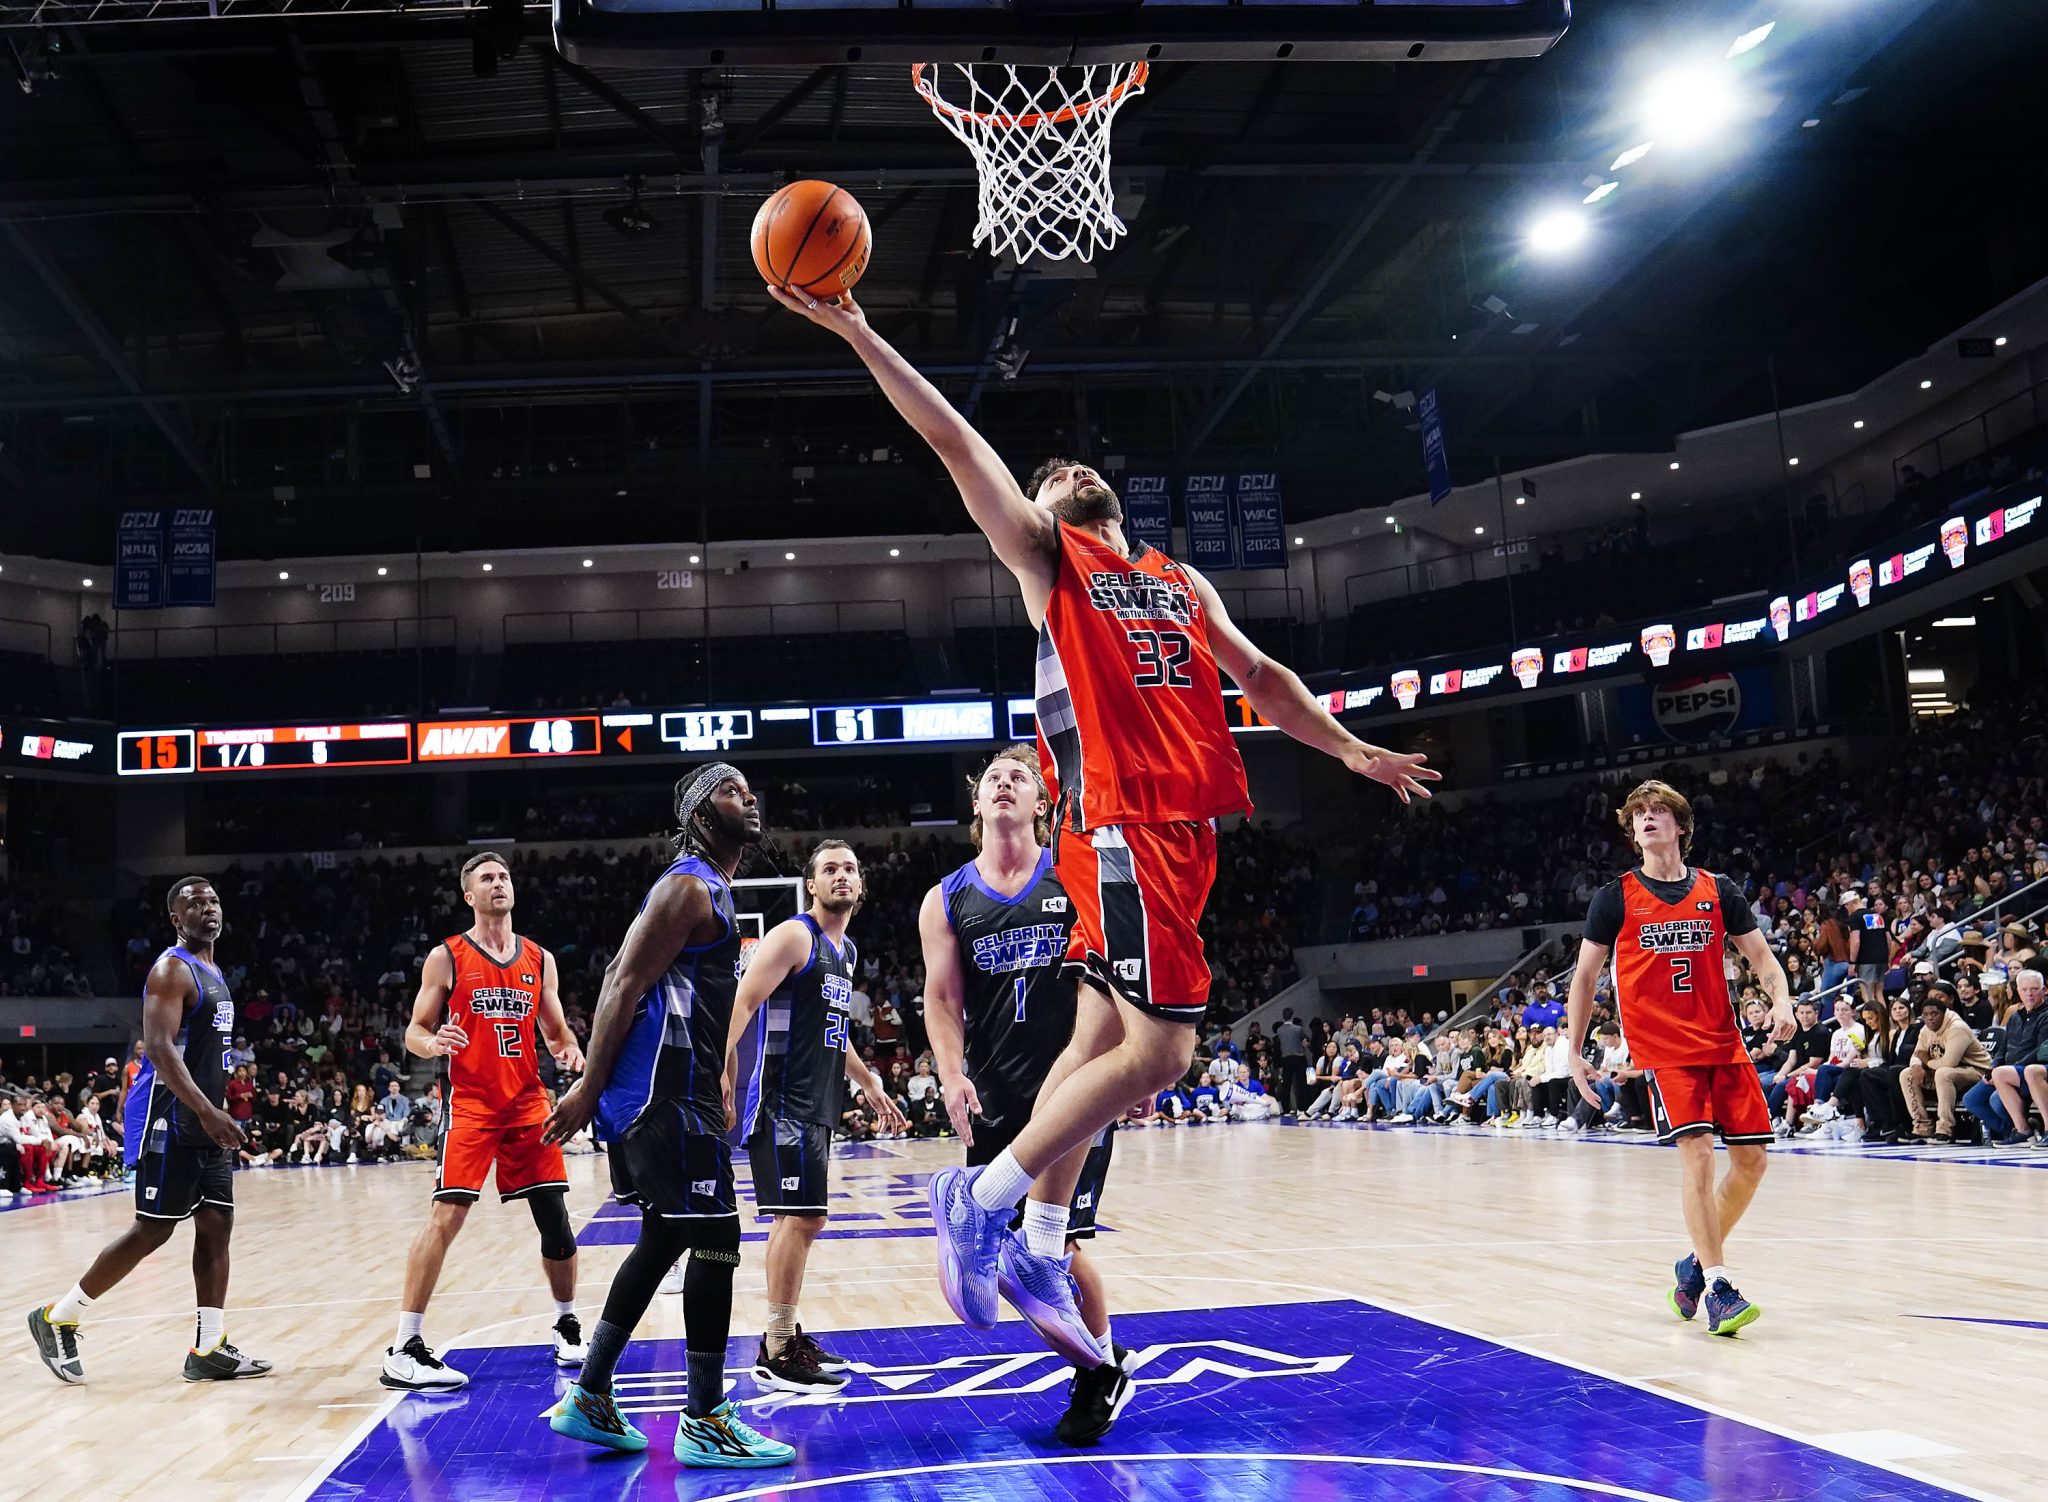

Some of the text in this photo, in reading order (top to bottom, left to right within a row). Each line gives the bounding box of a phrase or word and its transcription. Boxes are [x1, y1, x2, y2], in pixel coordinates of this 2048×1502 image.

[1128, 477, 1165, 493] GCU
[1187, 475, 1225, 491] GCU
[1239, 474, 1275, 490] GCU
[120, 512, 160, 528] GCU
[173, 509, 213, 525] GCU
[1132, 517, 1166, 529] WAC
[1191, 511, 1225, 522] WAC
[1243, 509, 1277, 520] WAC
[174, 543, 210, 554] NCAA
[1195, 540, 1226, 552] 2021
[1246, 538, 1280, 551] 2023
[657, 571, 692, 589] 208
[1090, 571, 1190, 593] CELEBRT
[321, 584, 355, 602] 209
[1116, 609, 1156, 620] MOTIVATE
[1165, 610, 1190, 627] IPIRE
[1128, 630, 1192, 688] 32
[1657, 687, 1736, 716] PEPSI
[835, 708, 875, 742] 51
[903, 706, 992, 738] HOME
[420, 726, 508, 756] AWAY
[529, 719, 574, 753] 46
[136, 735, 178, 770] 15
[312, 741, 328, 764] 5
[1640, 920, 1711, 936] CELEBRITY
[973, 924, 1064, 953] CELEBRITY
[1639, 931, 1714, 950] SWEAT
[974, 938, 1067, 970] SWEAT
[1671, 958, 1692, 993] 2
[472, 987, 533, 1002] CELEBRITY
[821, 984, 852, 1005] SWEA
[1014, 977, 1026, 1022] 1
[471, 998, 534, 1016] SWEAT
[494, 1023, 523, 1058] 12
[825, 1012, 849, 1053] 24
[1981, 1041, 1998, 1052] CU
